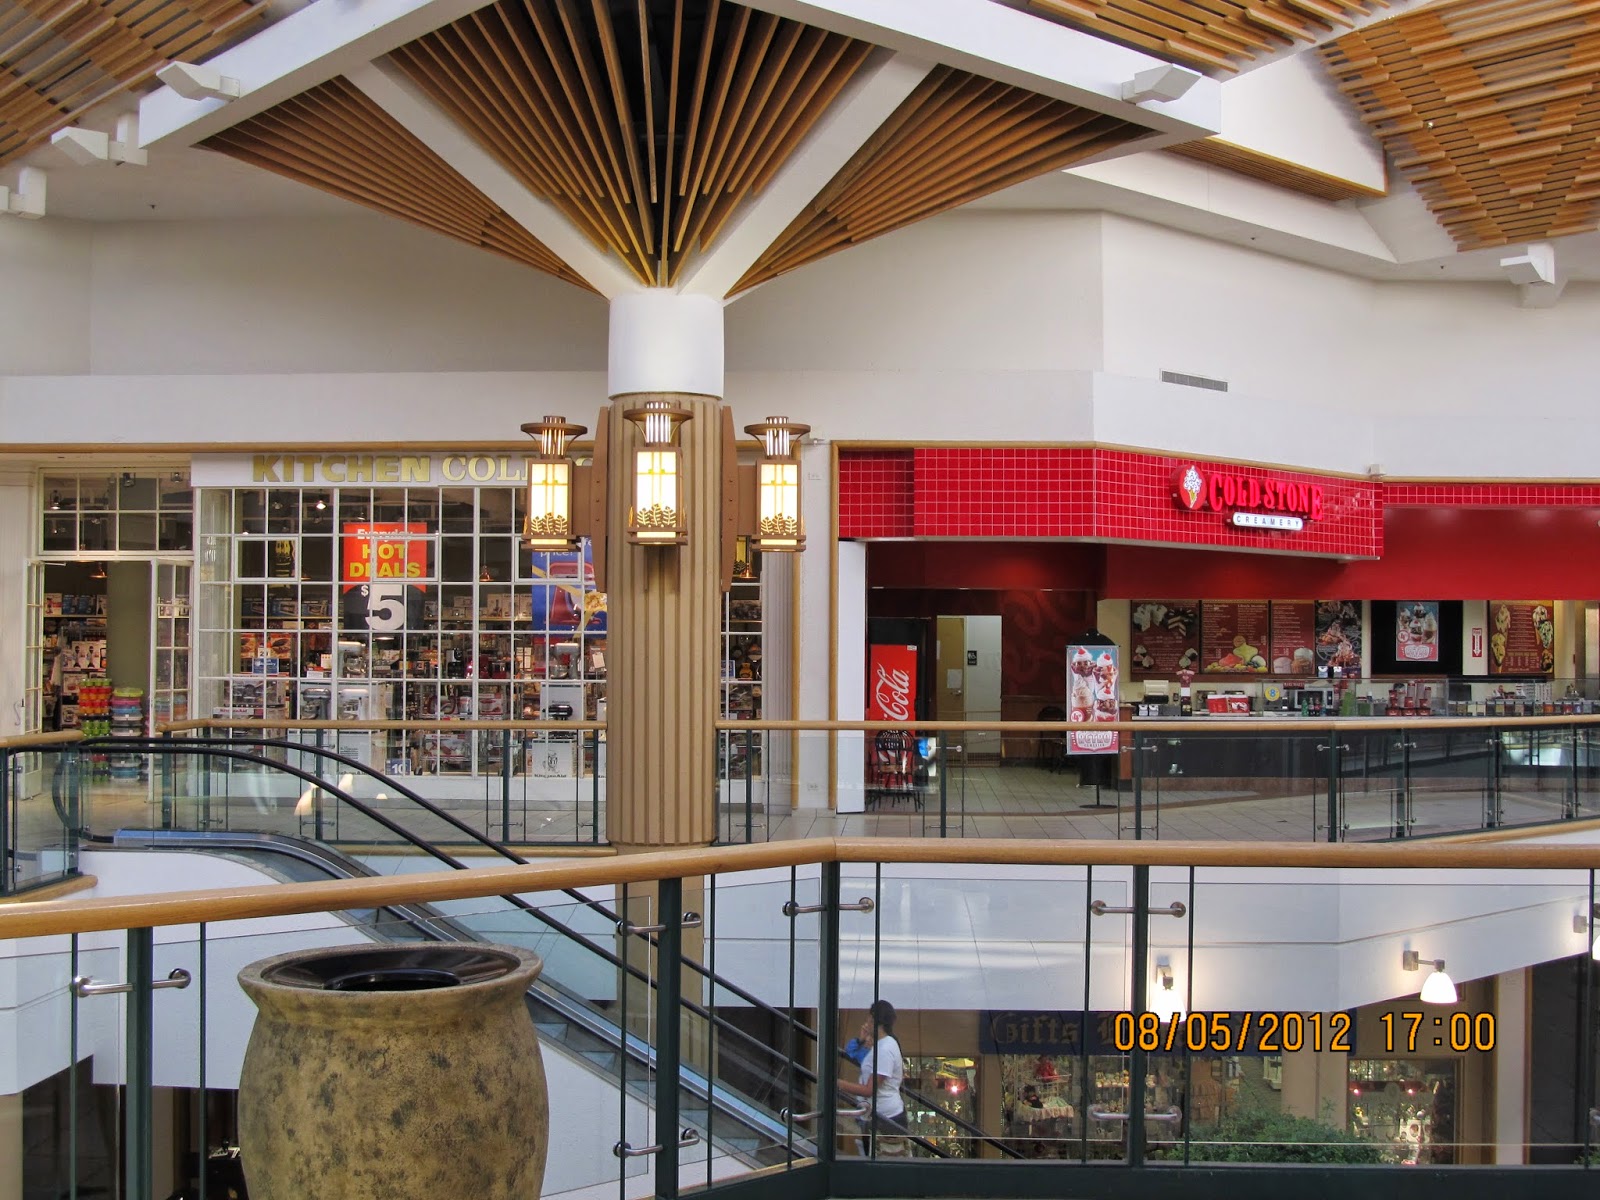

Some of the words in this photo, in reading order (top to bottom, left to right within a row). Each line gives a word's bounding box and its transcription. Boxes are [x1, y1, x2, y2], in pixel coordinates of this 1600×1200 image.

[252, 455, 430, 482] KITCHEN
[1209, 473, 1261, 511] COLD
[1263, 479, 1323, 520] STONE
[1236, 515, 1300, 527] CREAMERY
[362, 543, 409, 559] HOT
[990, 1011, 1080, 1044] Gifts
